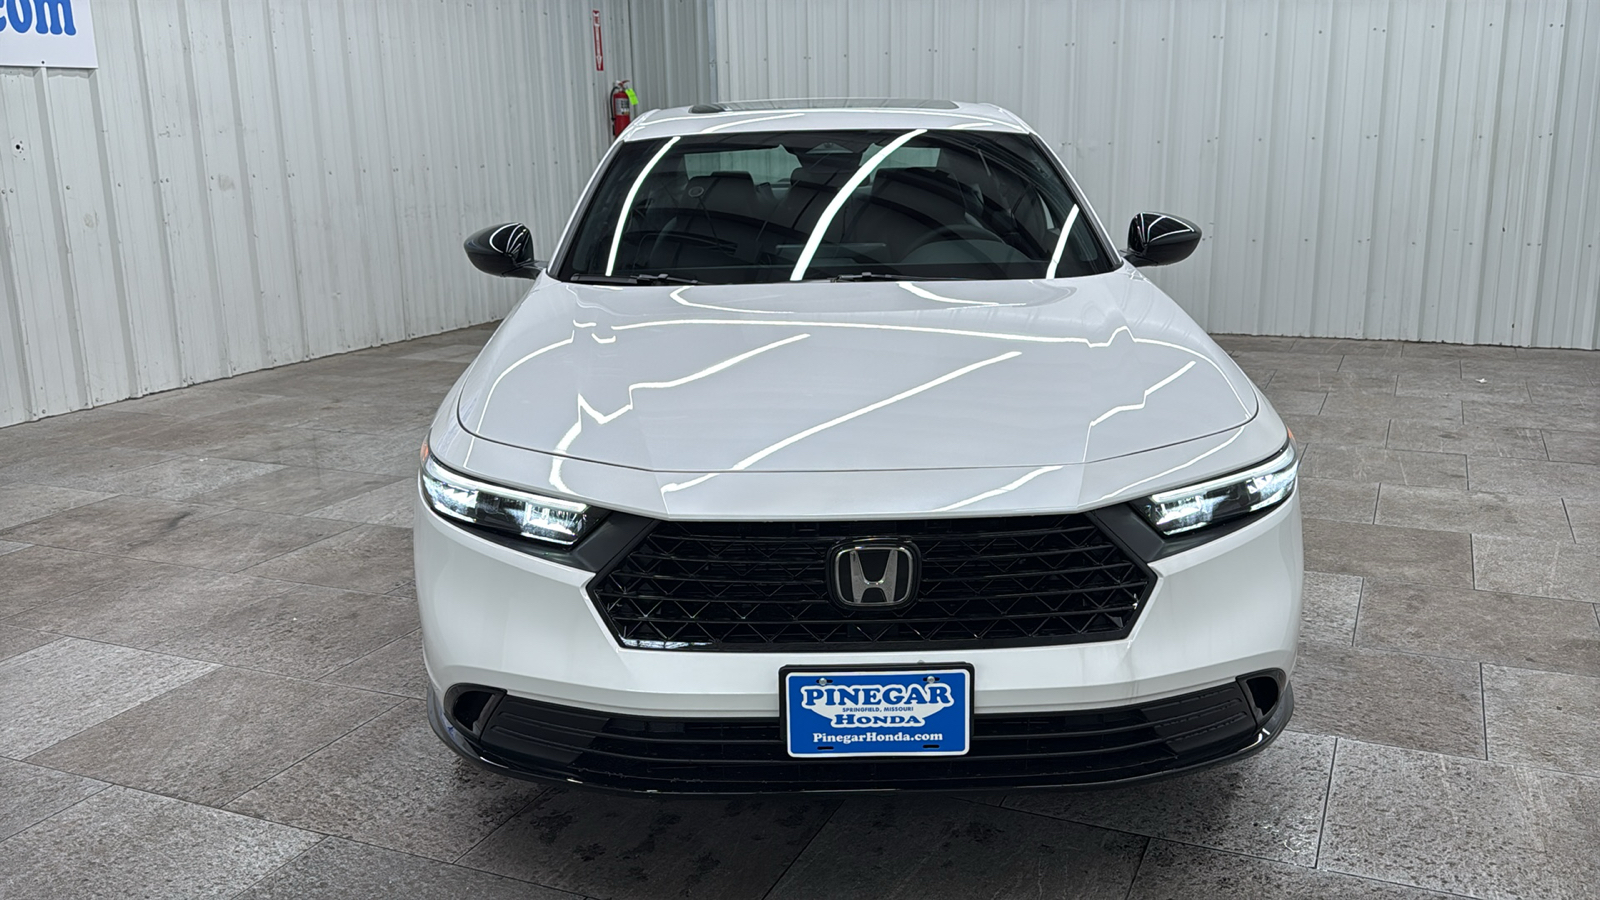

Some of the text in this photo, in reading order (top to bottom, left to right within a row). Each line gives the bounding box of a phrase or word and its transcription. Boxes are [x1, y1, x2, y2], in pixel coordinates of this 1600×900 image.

[0, 0, 77, 36] om
[803, 686, 951, 706] PINEGAR
[812, 731, 943, 744] PinegarHonda.com
